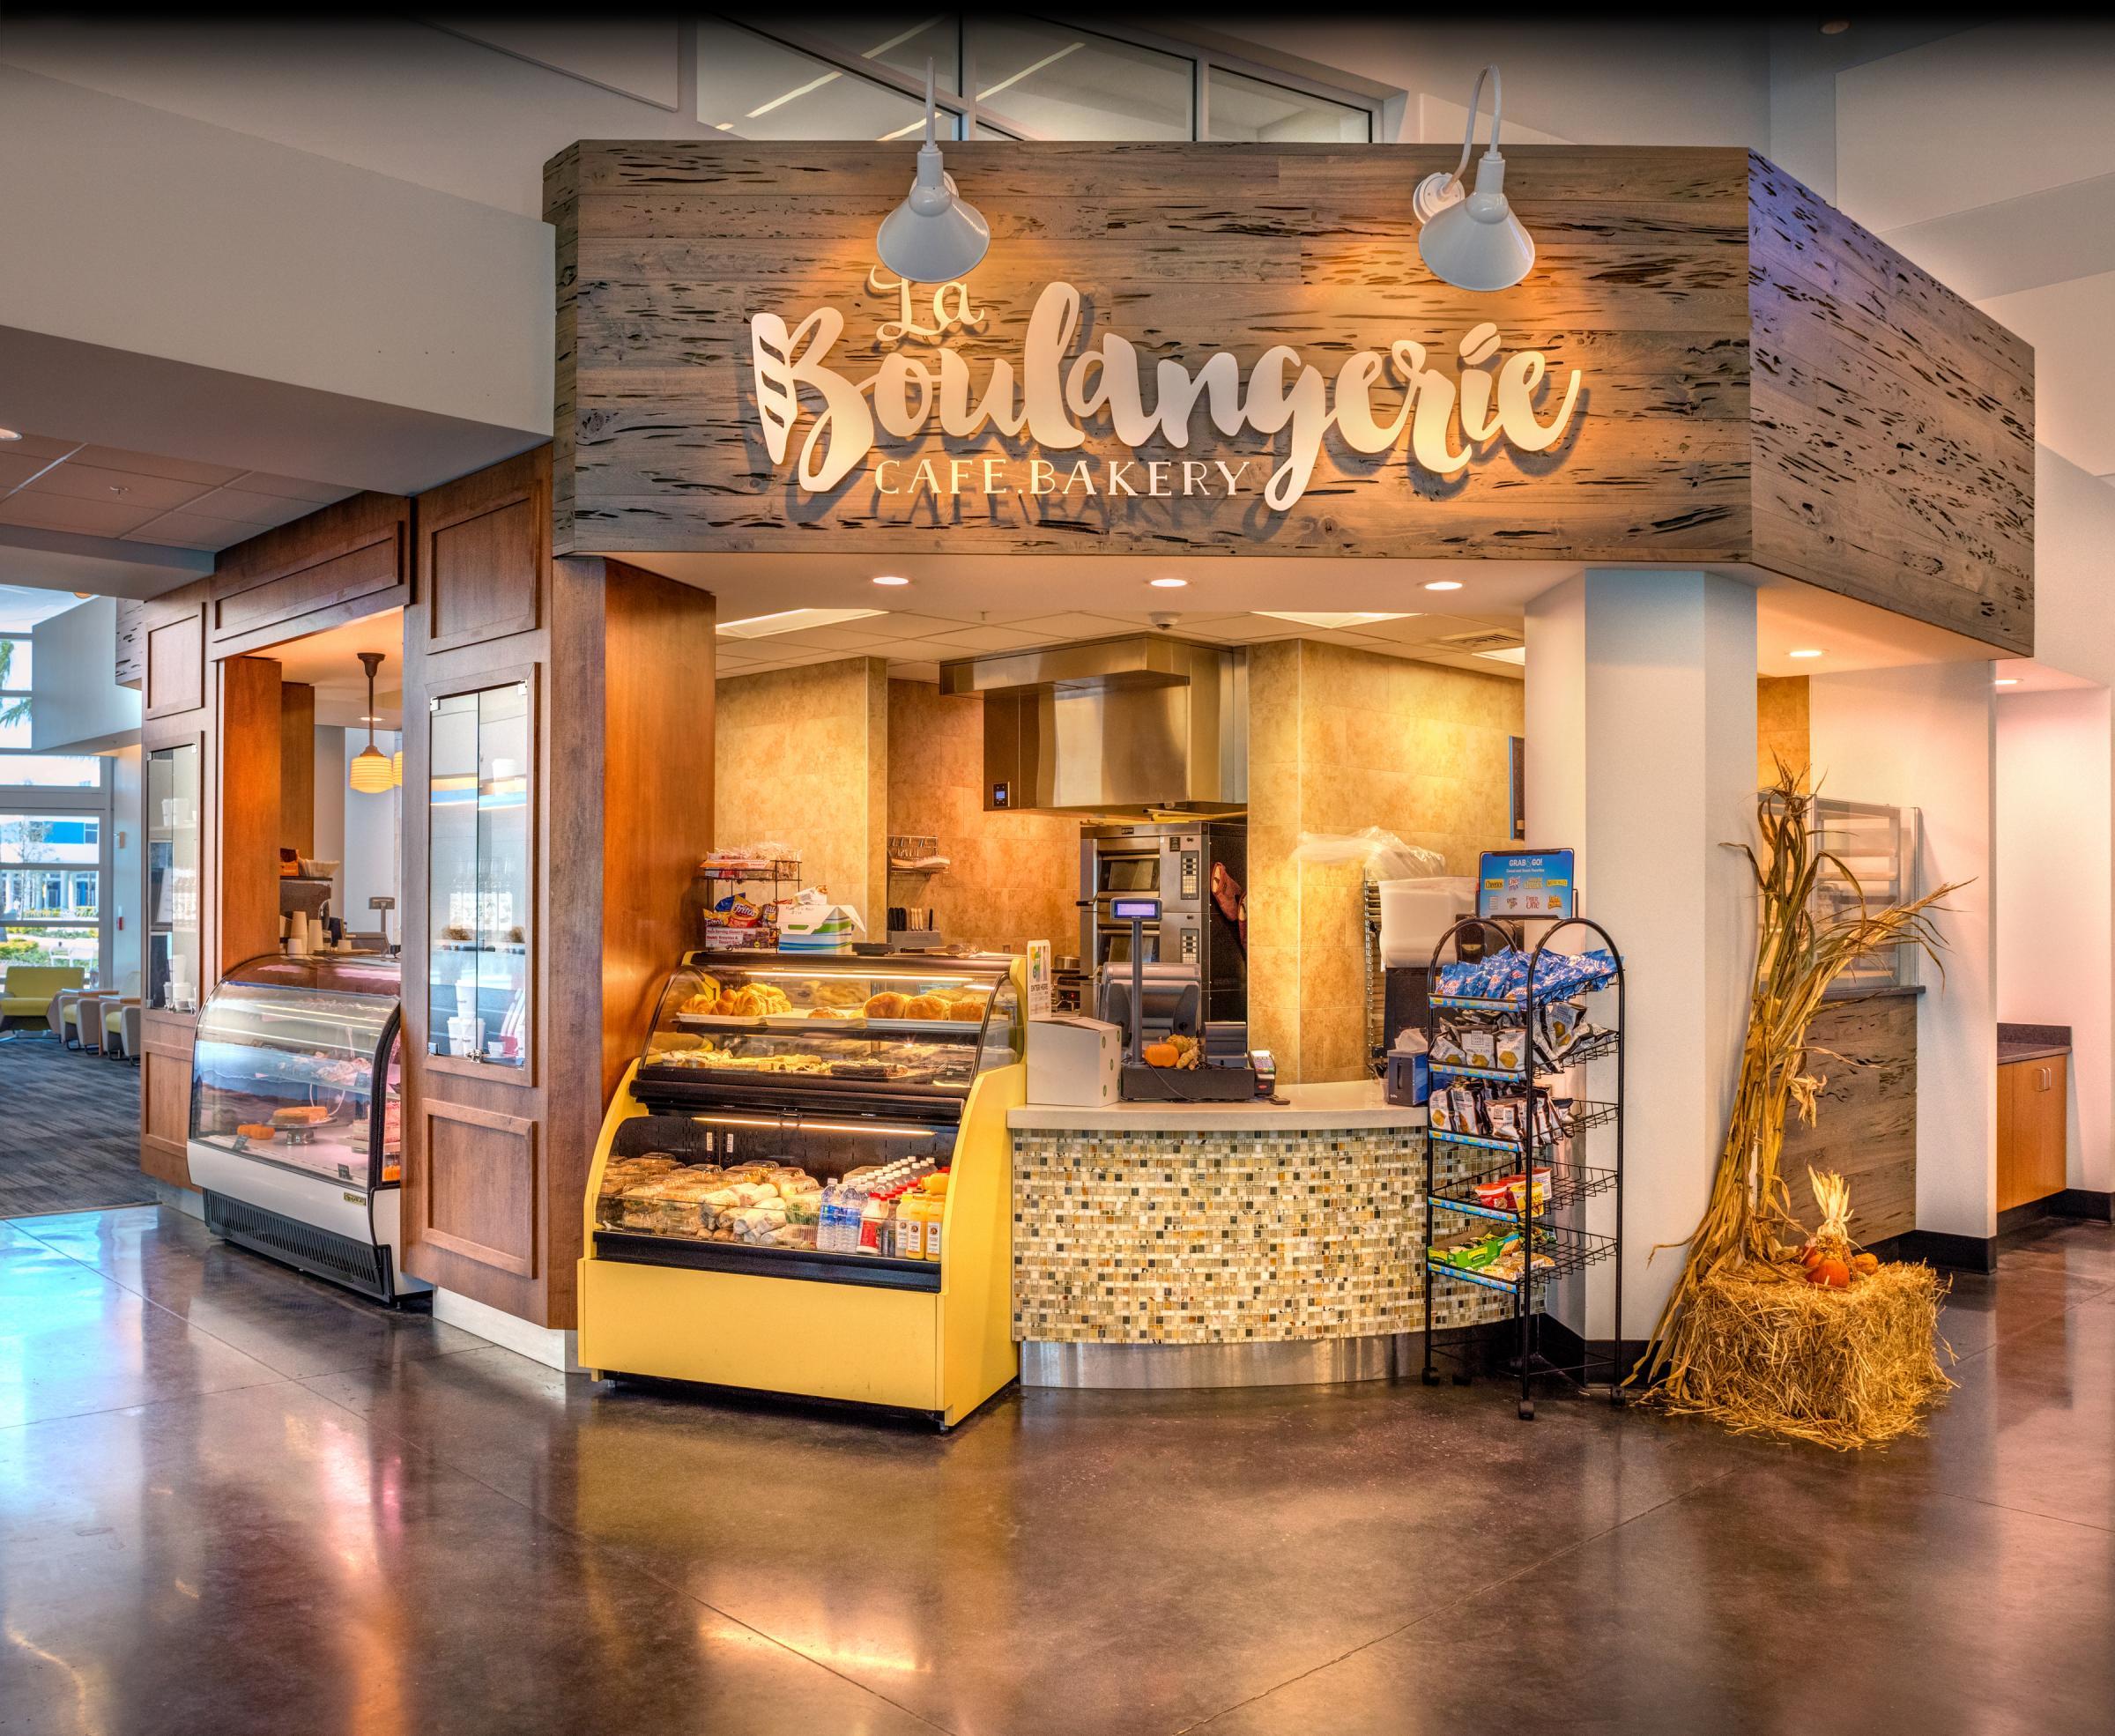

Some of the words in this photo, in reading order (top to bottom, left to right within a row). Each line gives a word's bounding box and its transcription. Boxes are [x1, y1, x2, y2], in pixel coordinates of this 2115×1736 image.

[869, 265, 984, 342] La
[752, 281, 1583, 512] Boulangerie
[735, 903, 755, 916] Fritos
